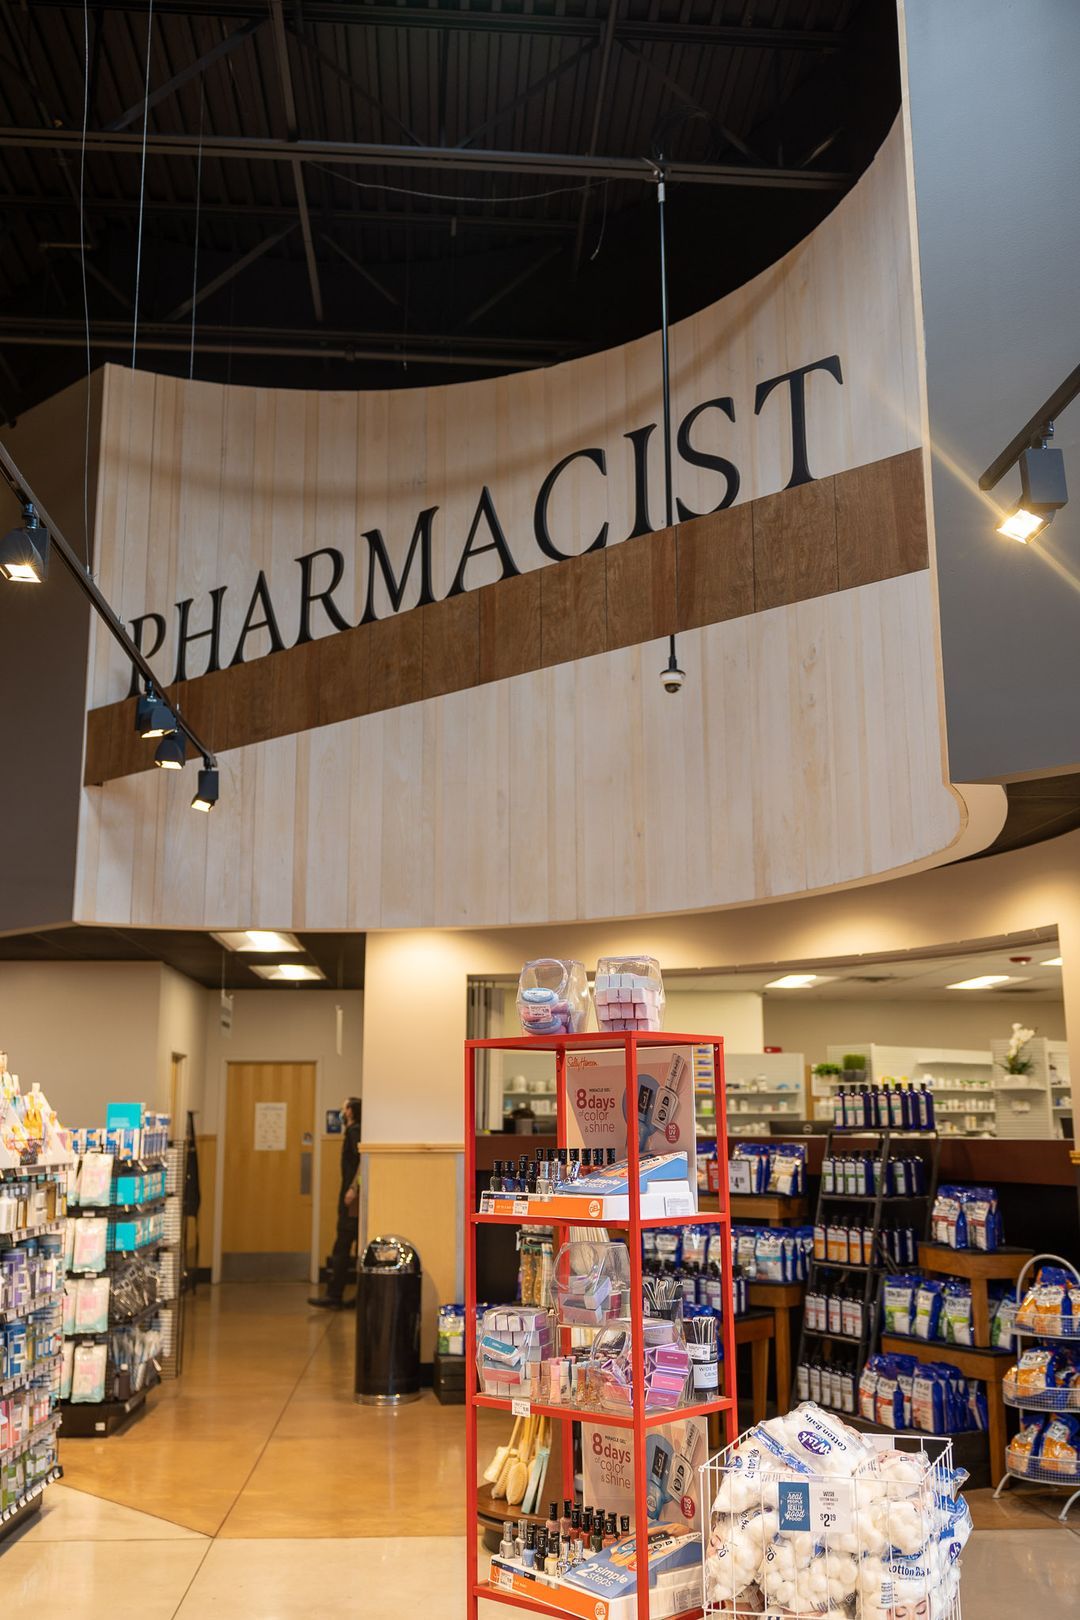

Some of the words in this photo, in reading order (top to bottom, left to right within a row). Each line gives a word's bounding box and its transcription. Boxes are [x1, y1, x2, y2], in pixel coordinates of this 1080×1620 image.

[127, 355, 844, 697] PHARMACIST
[576, 1089, 587, 1109] 8
[588, 1095, 616, 1111] days
[584, 1109, 609, 1121] color
[590, 1121, 615, 1132] shine
[592, 1433, 602, 1455] 8
[604, 1444, 631, 1464] days
[800, 1432, 832, 1455] Wish
[823, 1429, 847, 1451] Cotton
[600, 1460, 624, 1474] color
[606, 1472, 630, 1489] shine
[576, 1563, 595, 1578] 2
[596, 1564, 629, 1584] simple
[586, 1573, 615, 1588] steps
